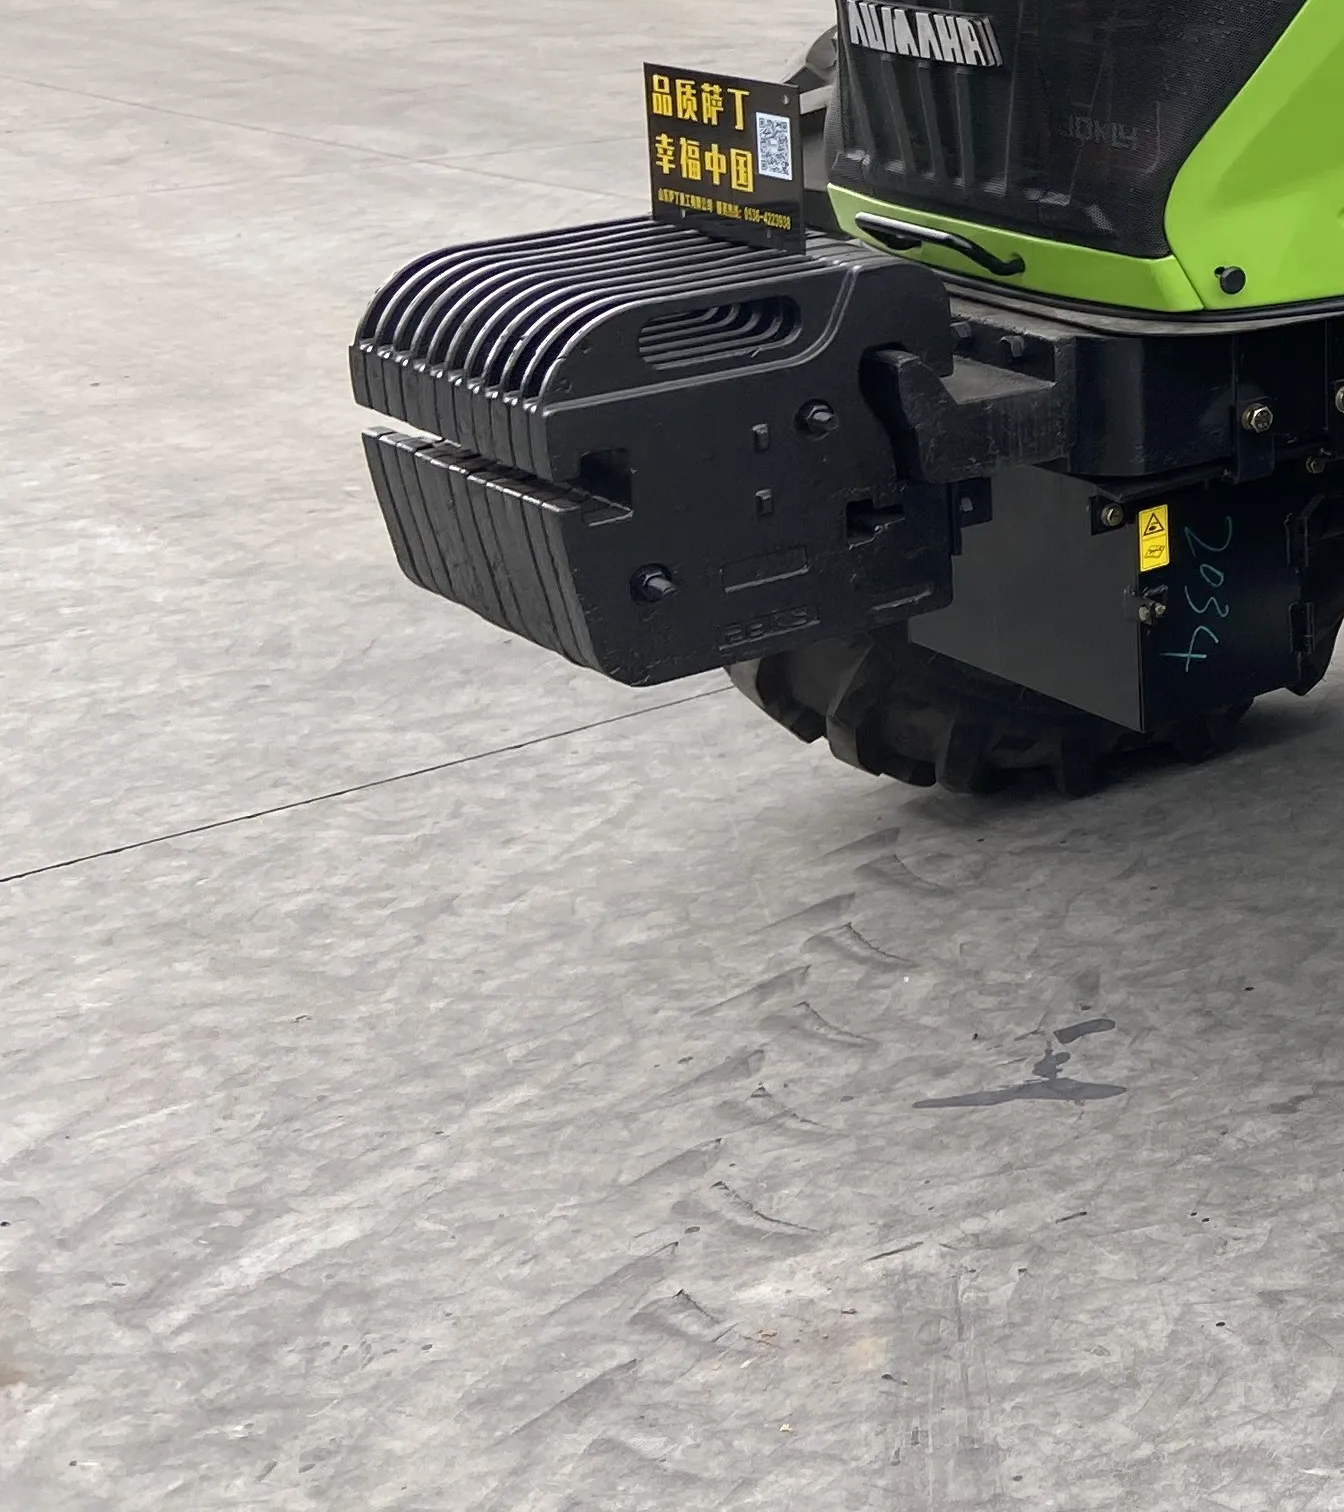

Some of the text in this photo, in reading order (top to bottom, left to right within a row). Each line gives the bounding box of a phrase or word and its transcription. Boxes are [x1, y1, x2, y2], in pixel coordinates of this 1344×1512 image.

[652, 73, 750, 131] 品质萨丁
[656, 133, 754, 193] 幸福中国
